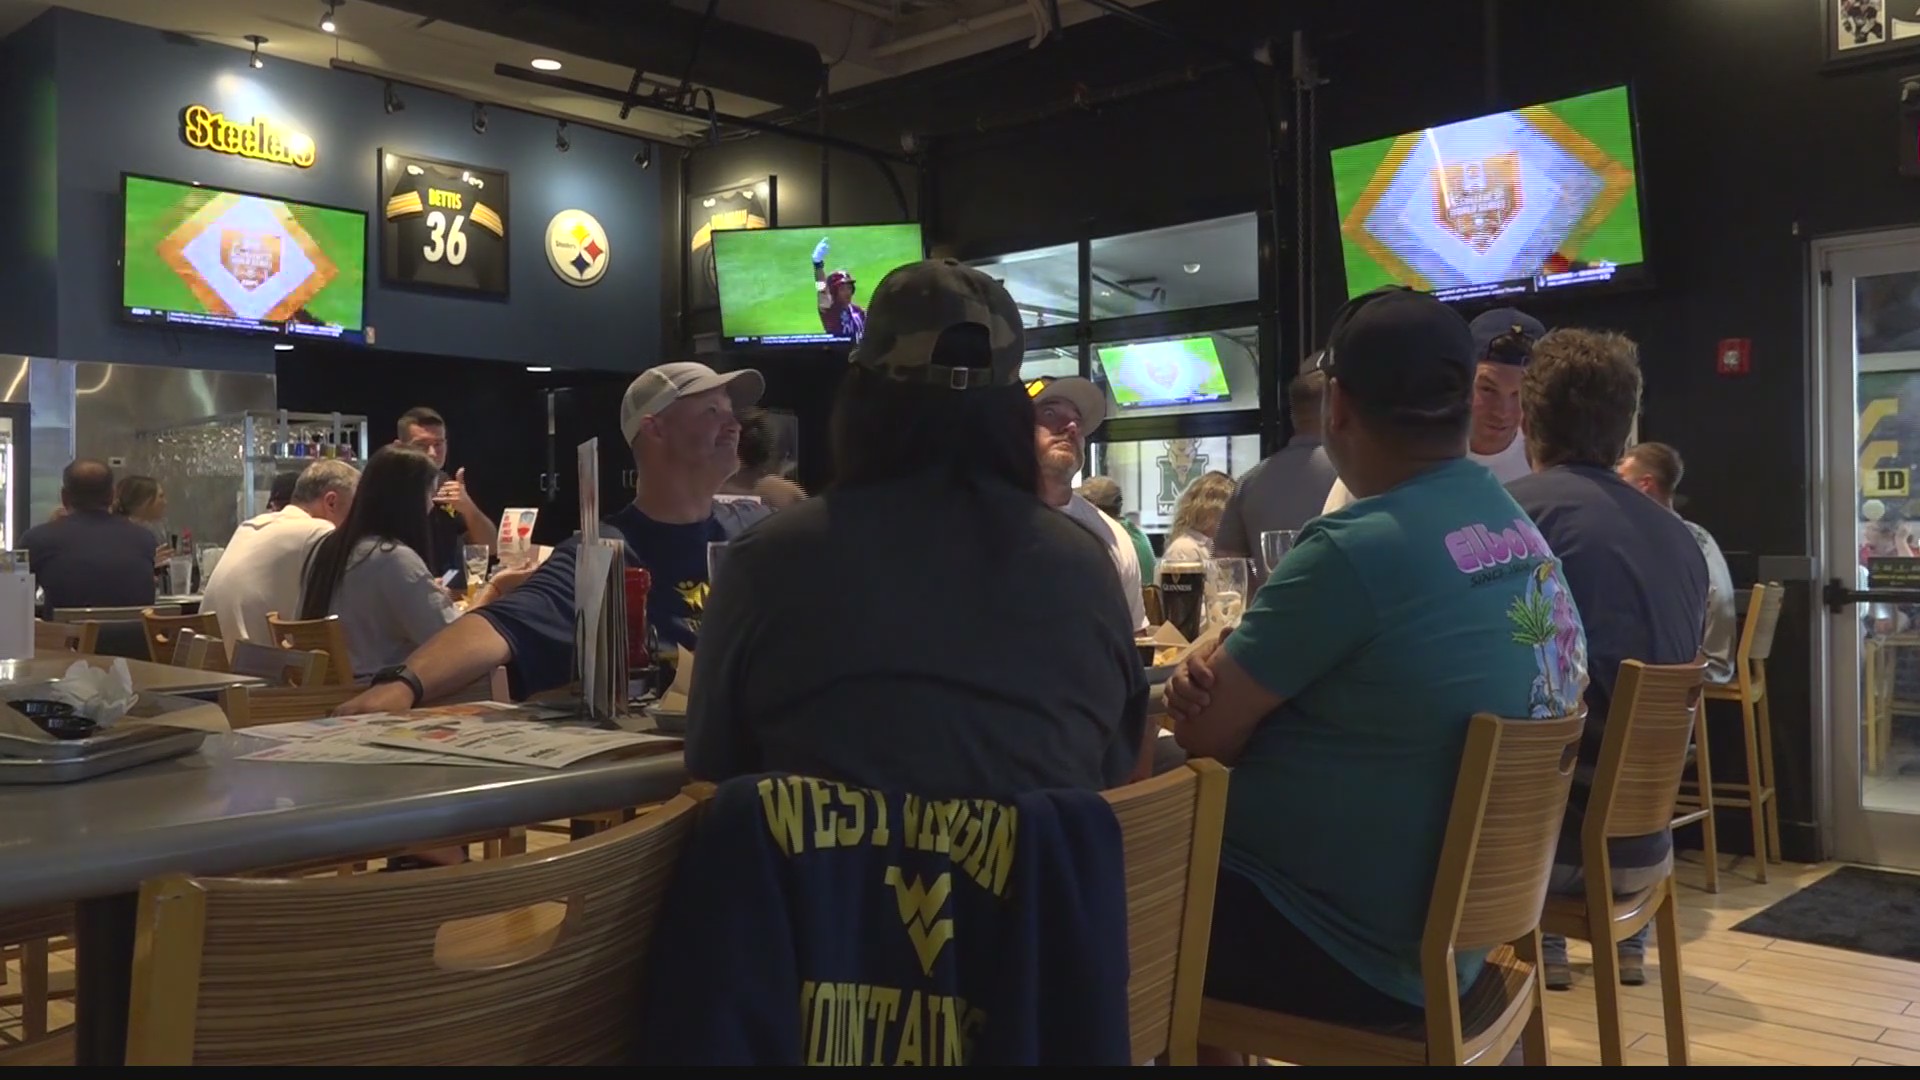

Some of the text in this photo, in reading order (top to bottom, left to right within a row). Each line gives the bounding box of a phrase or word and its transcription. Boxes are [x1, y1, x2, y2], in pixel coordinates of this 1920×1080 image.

[428, 188, 462, 210] BETTIS
[423, 211, 467, 265] 36
[1878, 471, 1905, 490] ID
[757, 776, 889, 855] WEST
